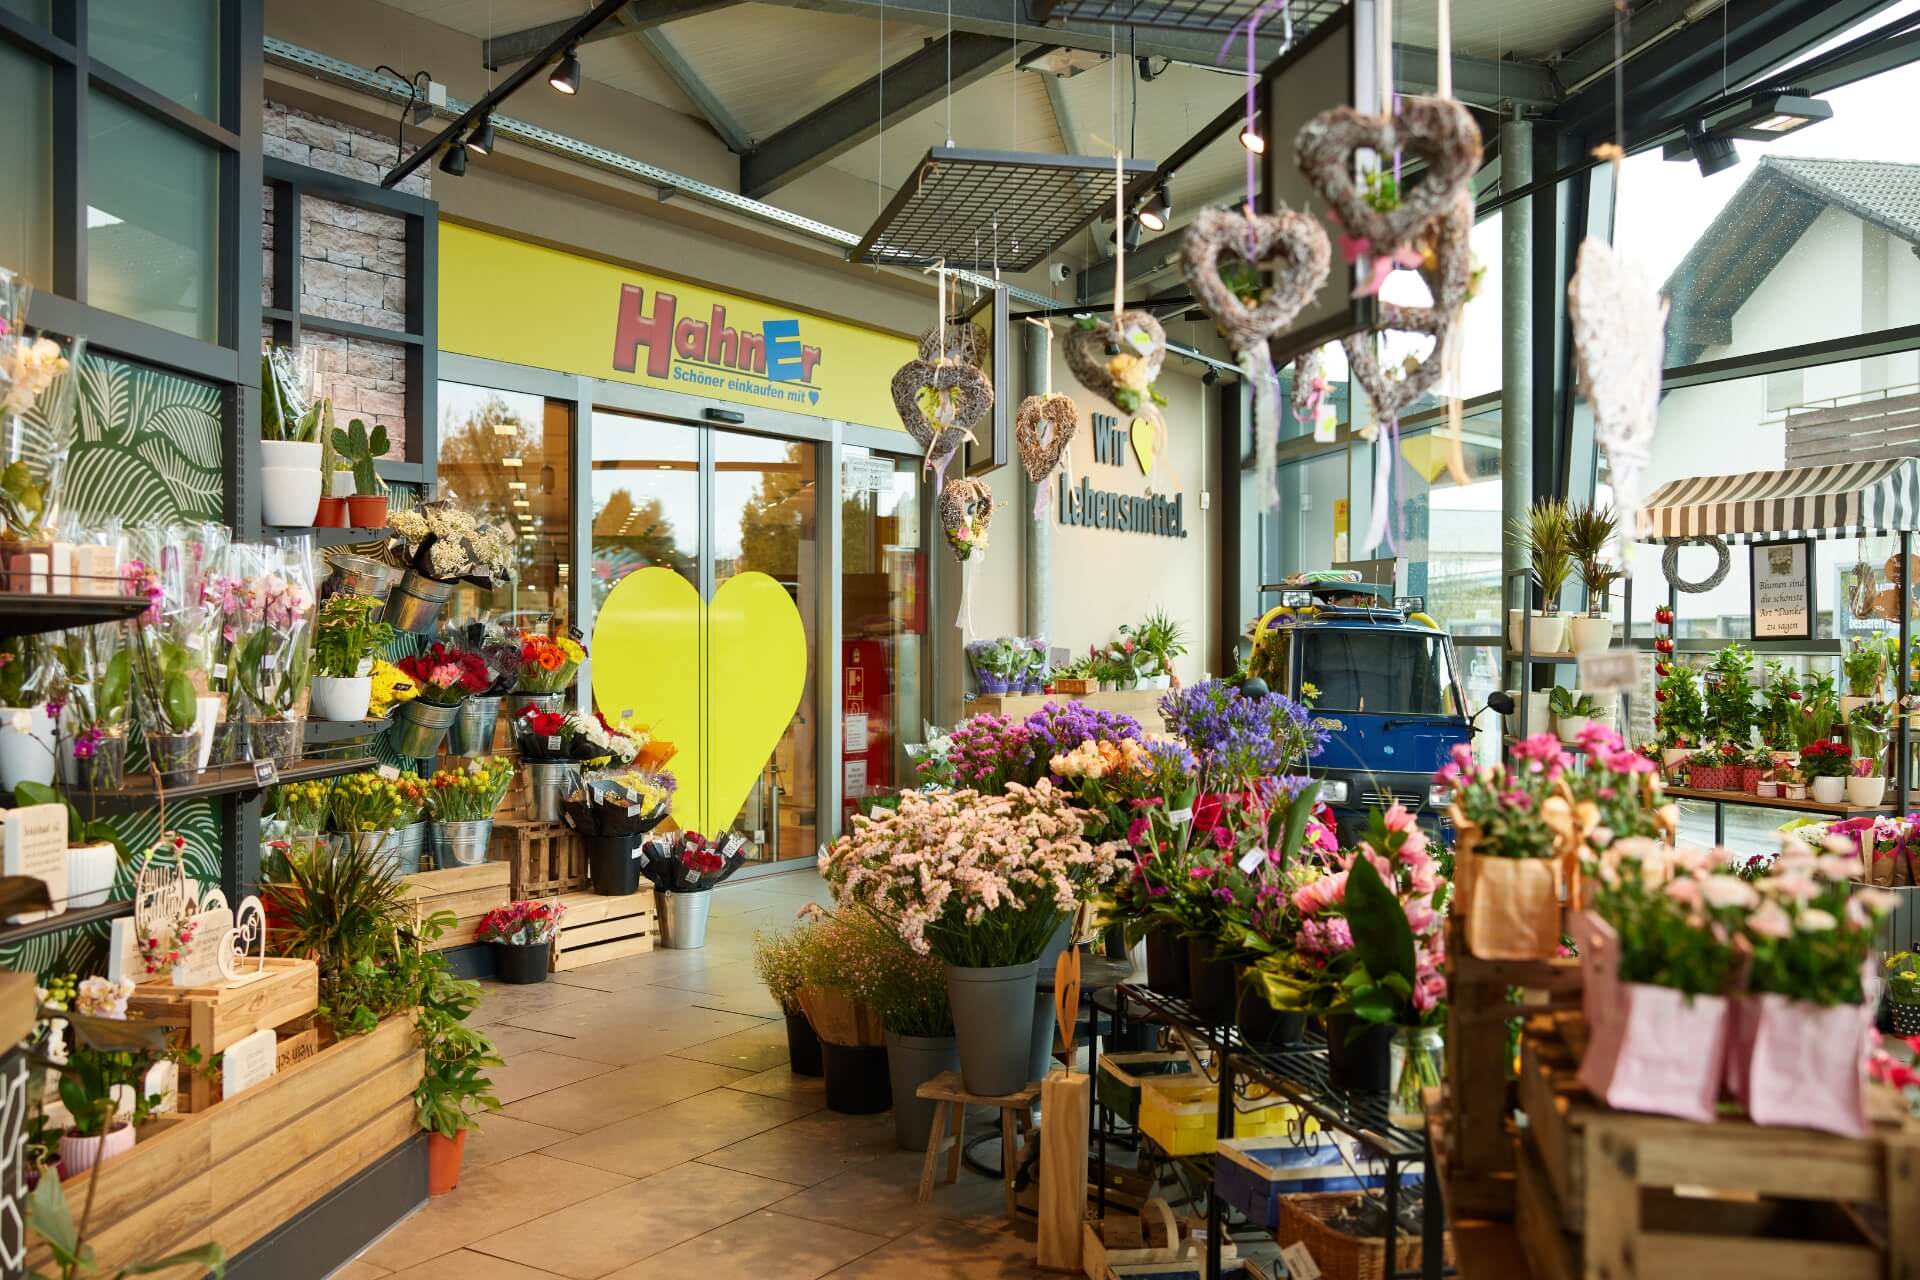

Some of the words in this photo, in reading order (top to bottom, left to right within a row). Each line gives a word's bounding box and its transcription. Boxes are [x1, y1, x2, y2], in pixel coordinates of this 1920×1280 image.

[672, 367, 725, 389] Schöner
[727, 378, 784, 400] einkaufen
[788, 390, 805, 403] mit
[1091, 412, 1127, 467] Wir
[1759, 581, 1787, 590] Blumen
[1788, 576, 1807, 588] sind
[1760, 593, 1770, 603] die
[1759, 608, 1773, 617] Art
[1777, 622, 1798, 634] sagen
